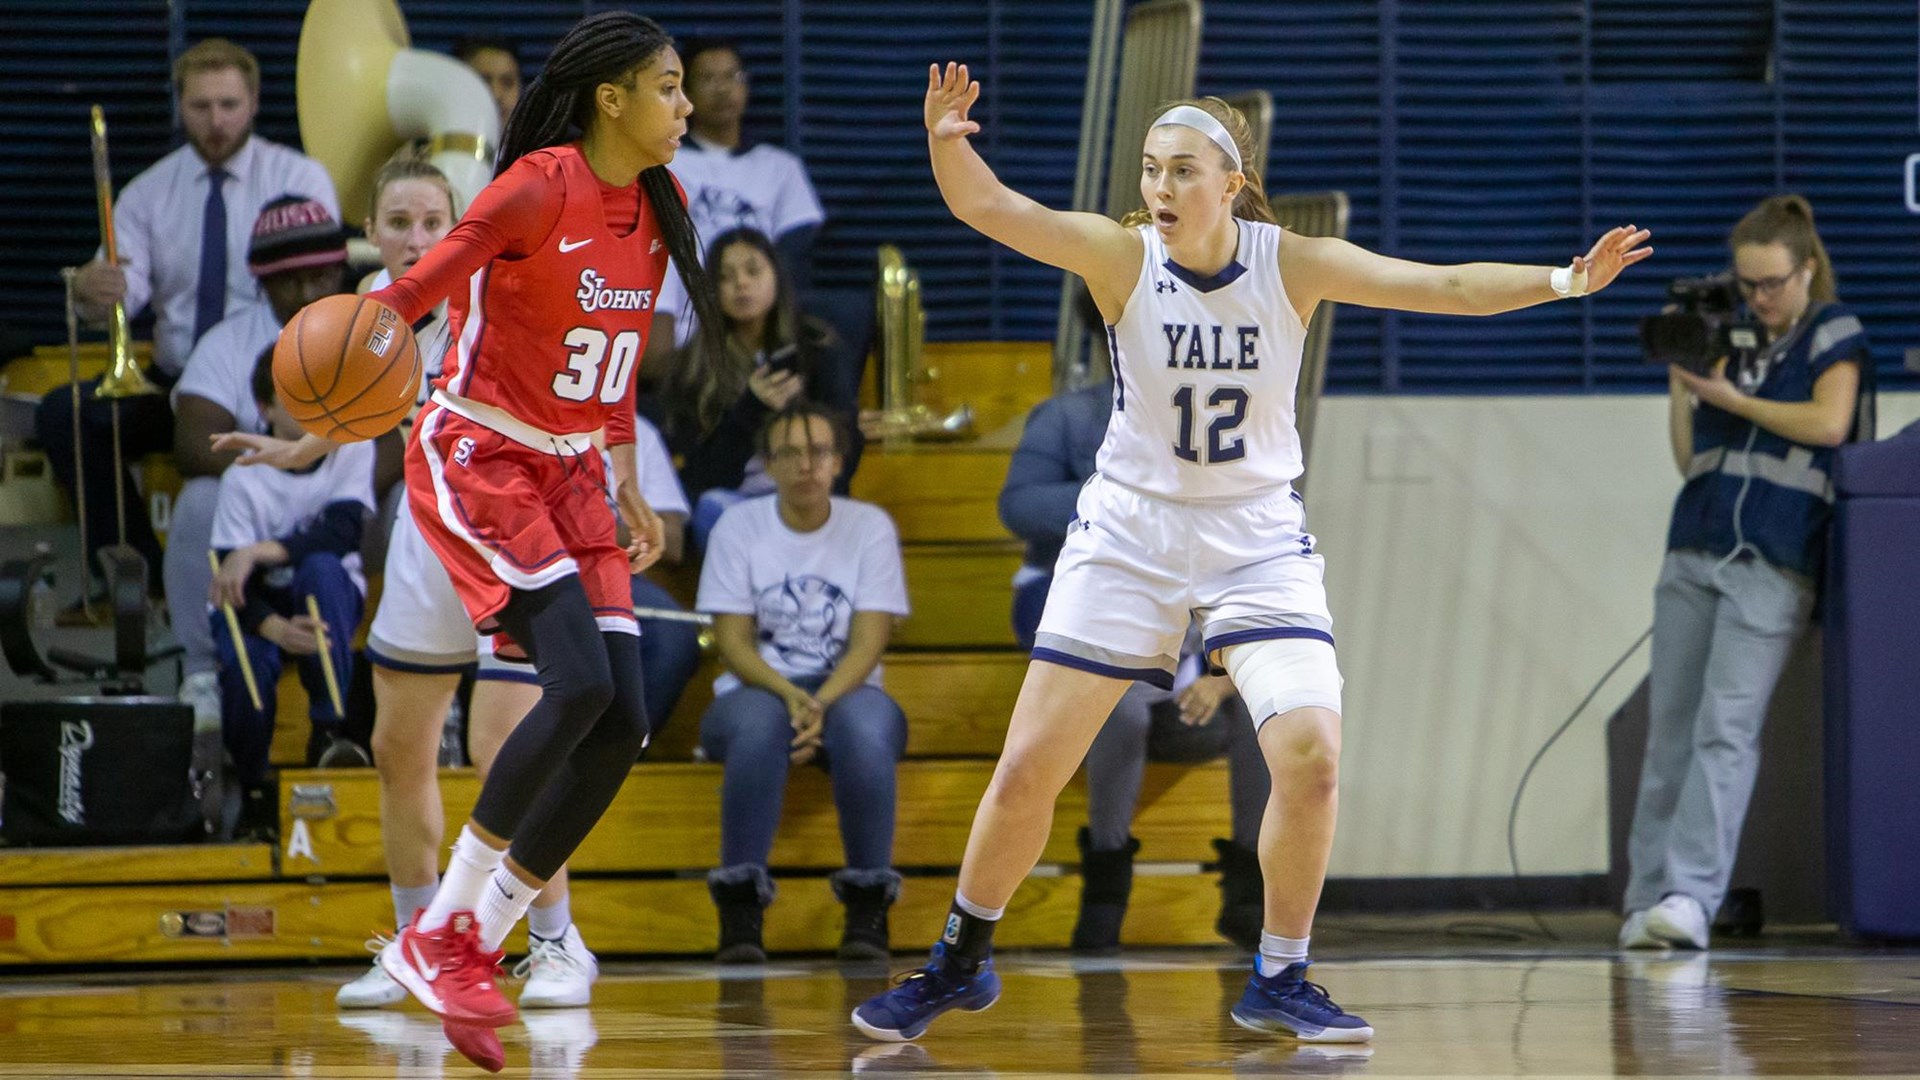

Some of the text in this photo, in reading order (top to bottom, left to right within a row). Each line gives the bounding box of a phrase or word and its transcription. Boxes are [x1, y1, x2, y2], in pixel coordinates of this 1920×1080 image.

[551, 326, 640, 404] 30
[1163, 323, 1260, 370] YALE
[1171, 383, 1252, 467] 12
[287, 818, 313, 859] A
